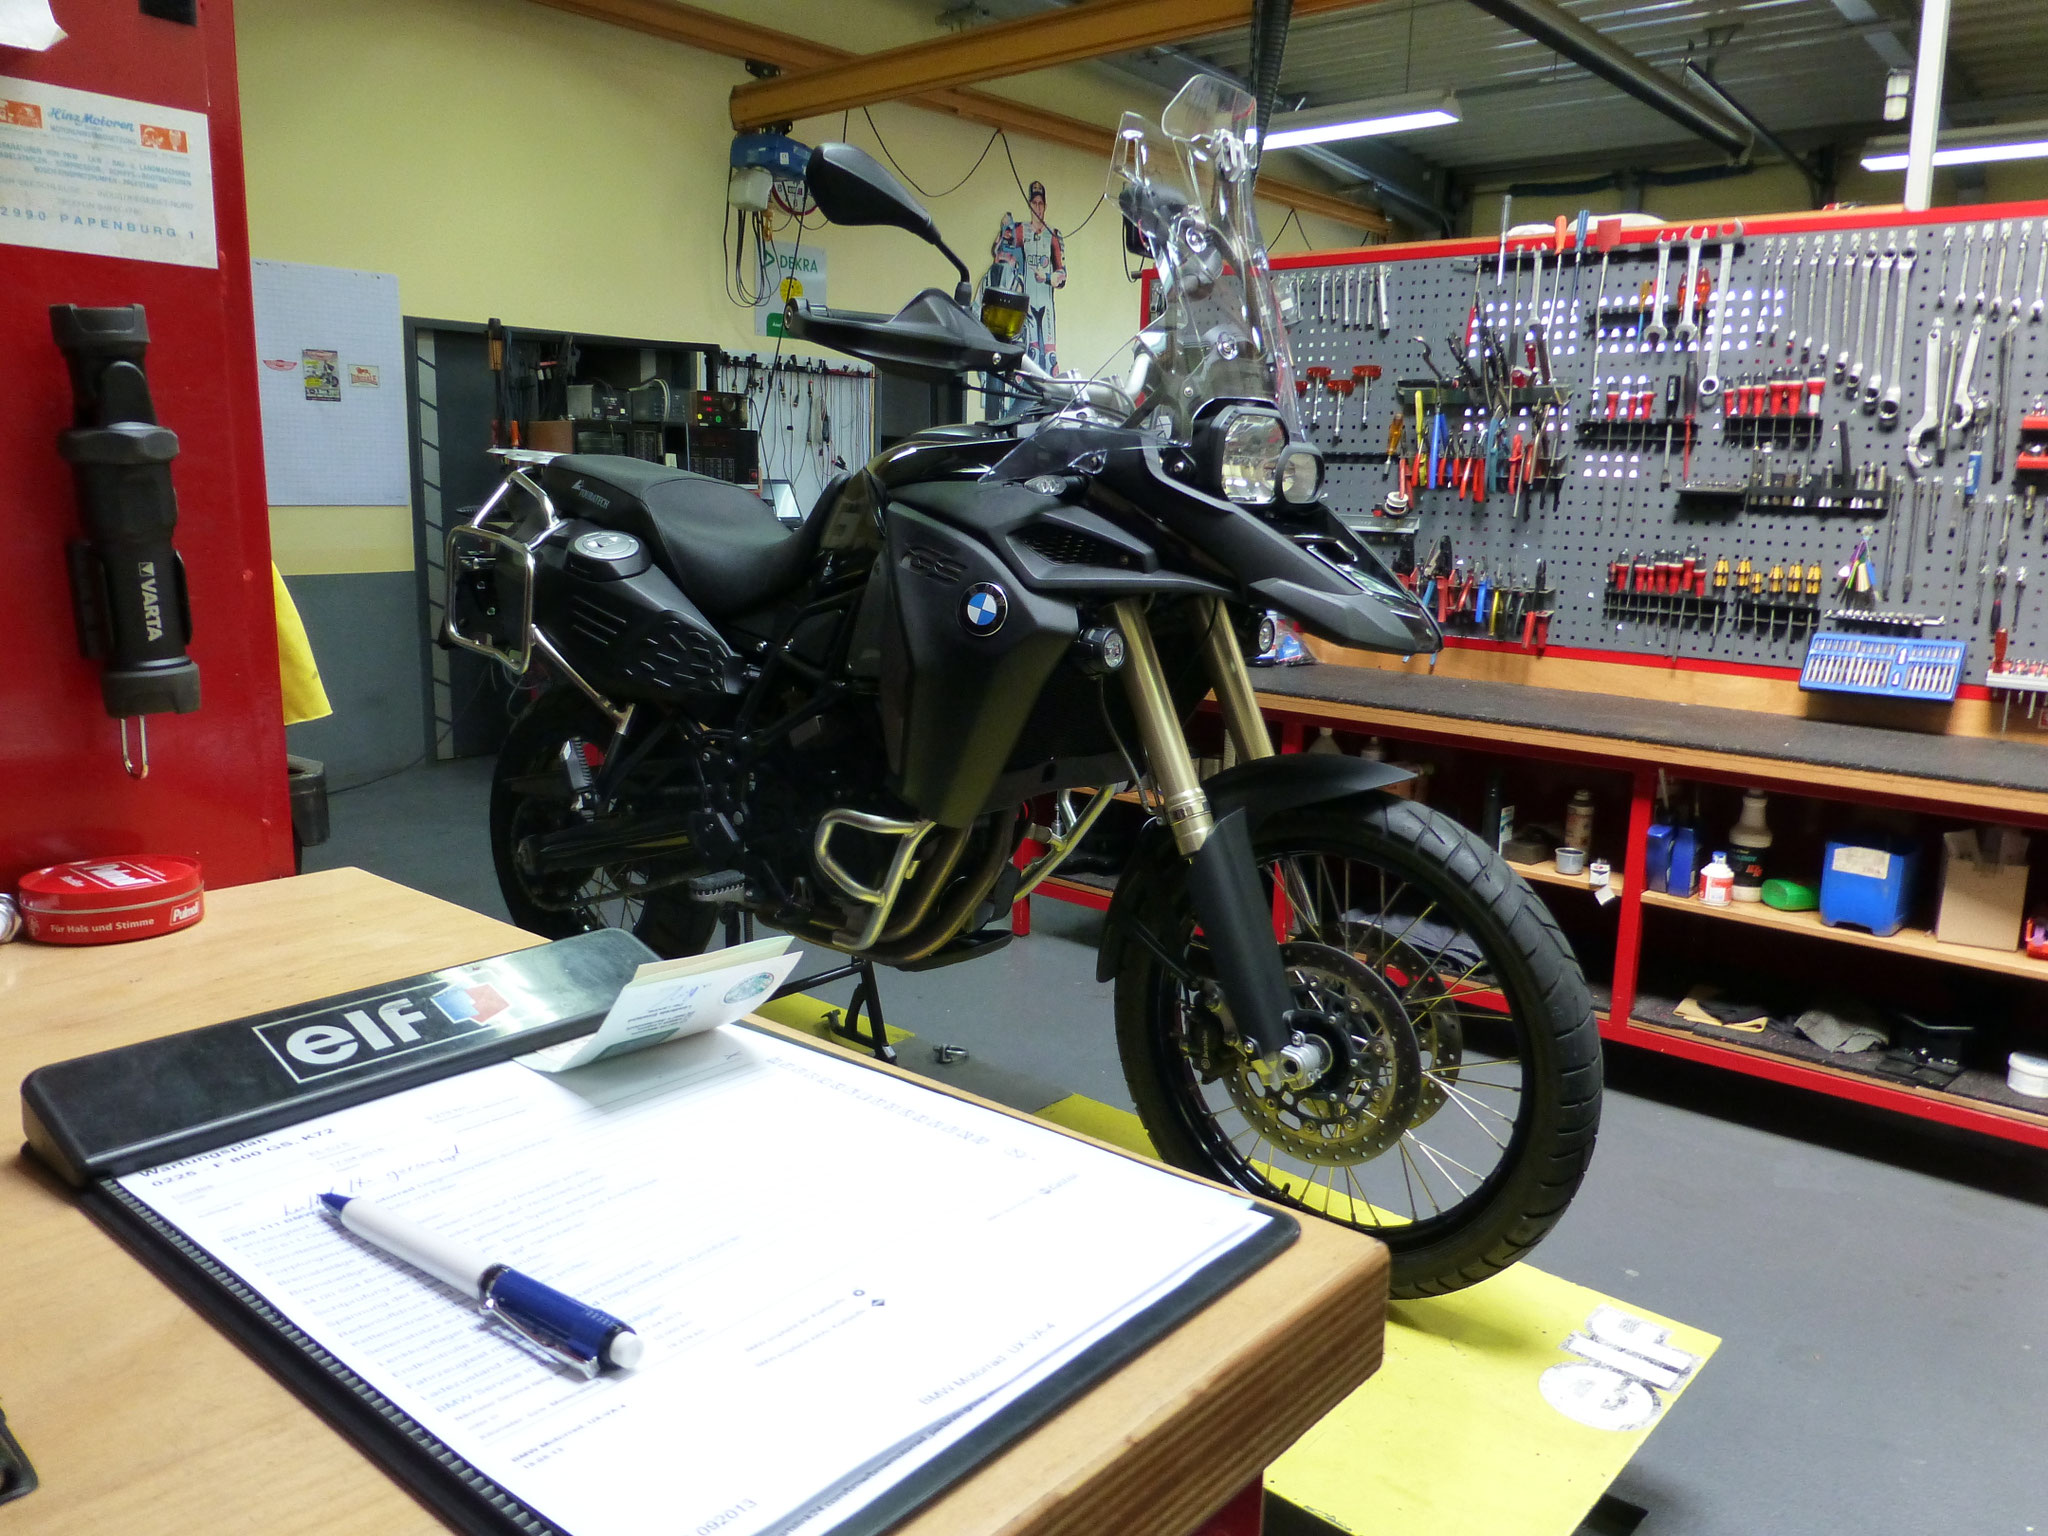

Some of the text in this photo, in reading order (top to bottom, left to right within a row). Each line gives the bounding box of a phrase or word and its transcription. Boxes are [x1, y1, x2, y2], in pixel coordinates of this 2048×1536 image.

[49, 106, 135, 132] Hinz Motoren
[0, 206, 195, 240] 2990 PAPENBURG 1
[779, 254, 819, 274] DEKRA
[578, 489, 610, 509] TOURATECH
[140, 577, 163, 642] VARTA
[50, 918, 155, 934] Für Hals und Stimme
[286, 997, 428, 1065] elf
[300, 1128, 336, 1140] K72
[138, 1136, 270, 1178] Wartungsplan
[1539, 1304, 1700, 1431] elf
[695, 1498, 760, 1536] 092013
